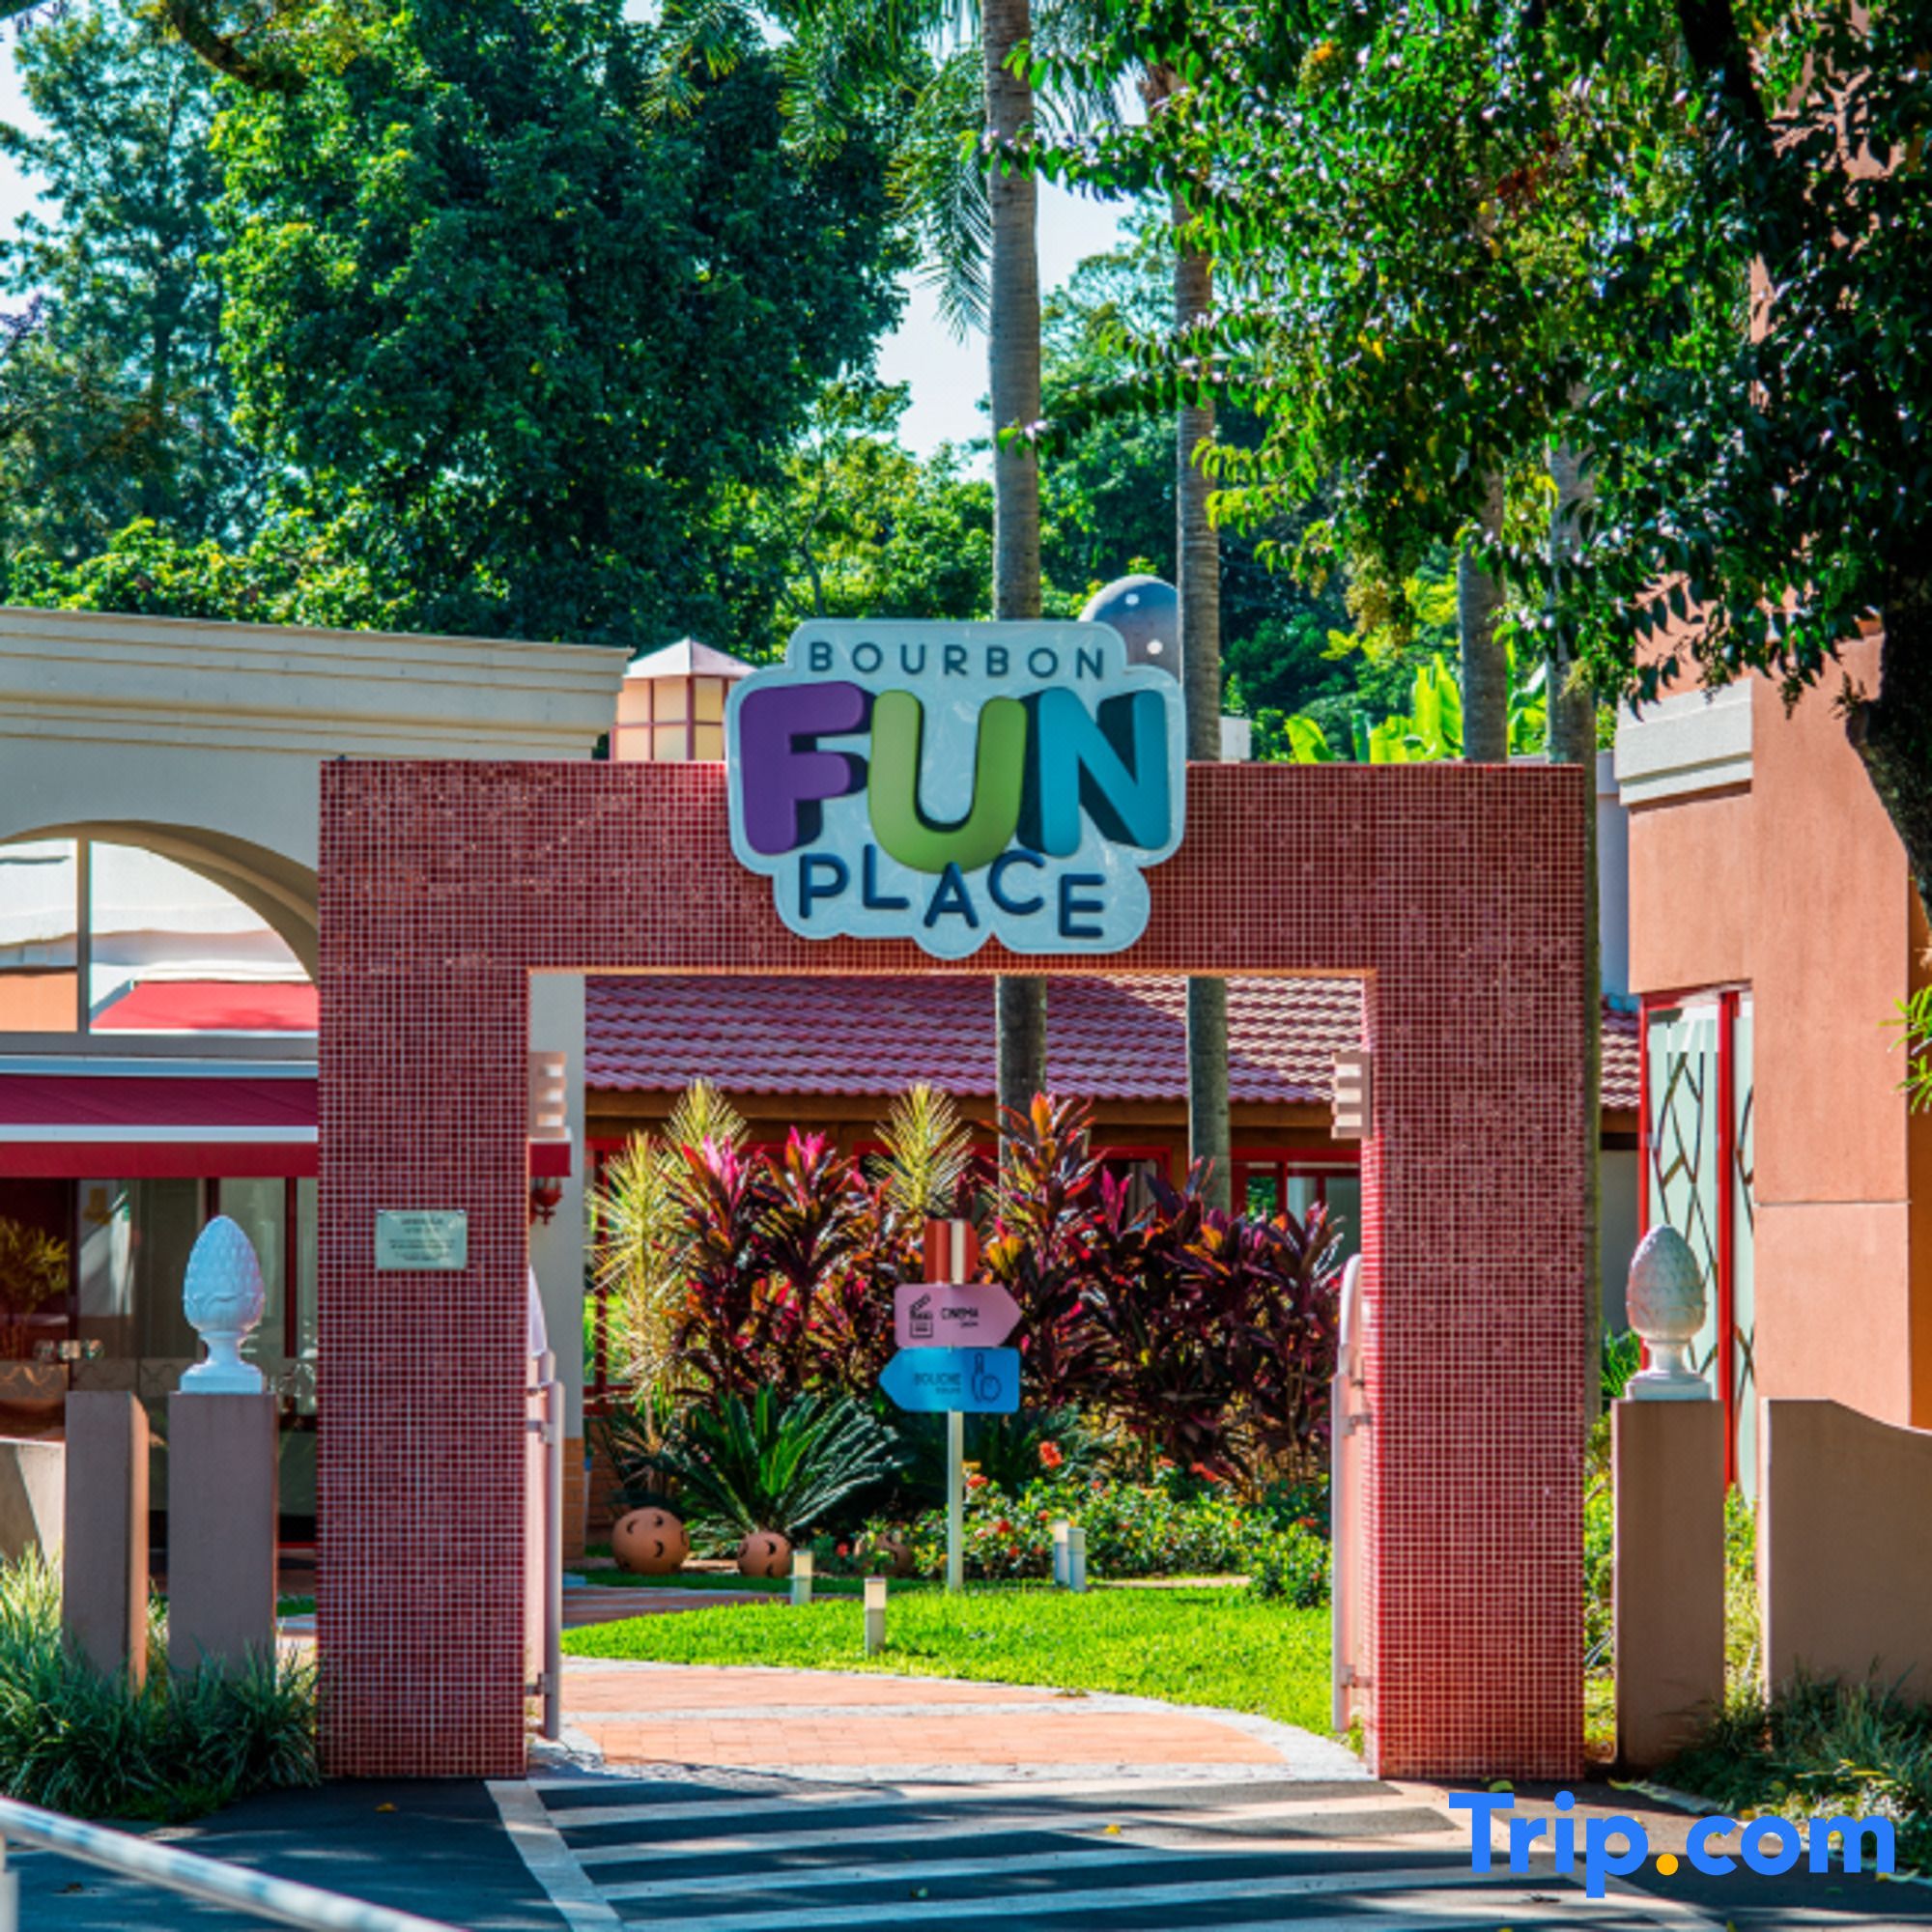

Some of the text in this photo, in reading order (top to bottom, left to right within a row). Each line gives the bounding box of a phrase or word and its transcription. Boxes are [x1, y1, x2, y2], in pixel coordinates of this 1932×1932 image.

[810, 641, 1104, 680] BOURBON
[739, 680, 1172, 874] FUN
[799, 843, 1106, 938] PLACE
[941, 1307, 980, 1320] CINEMA
